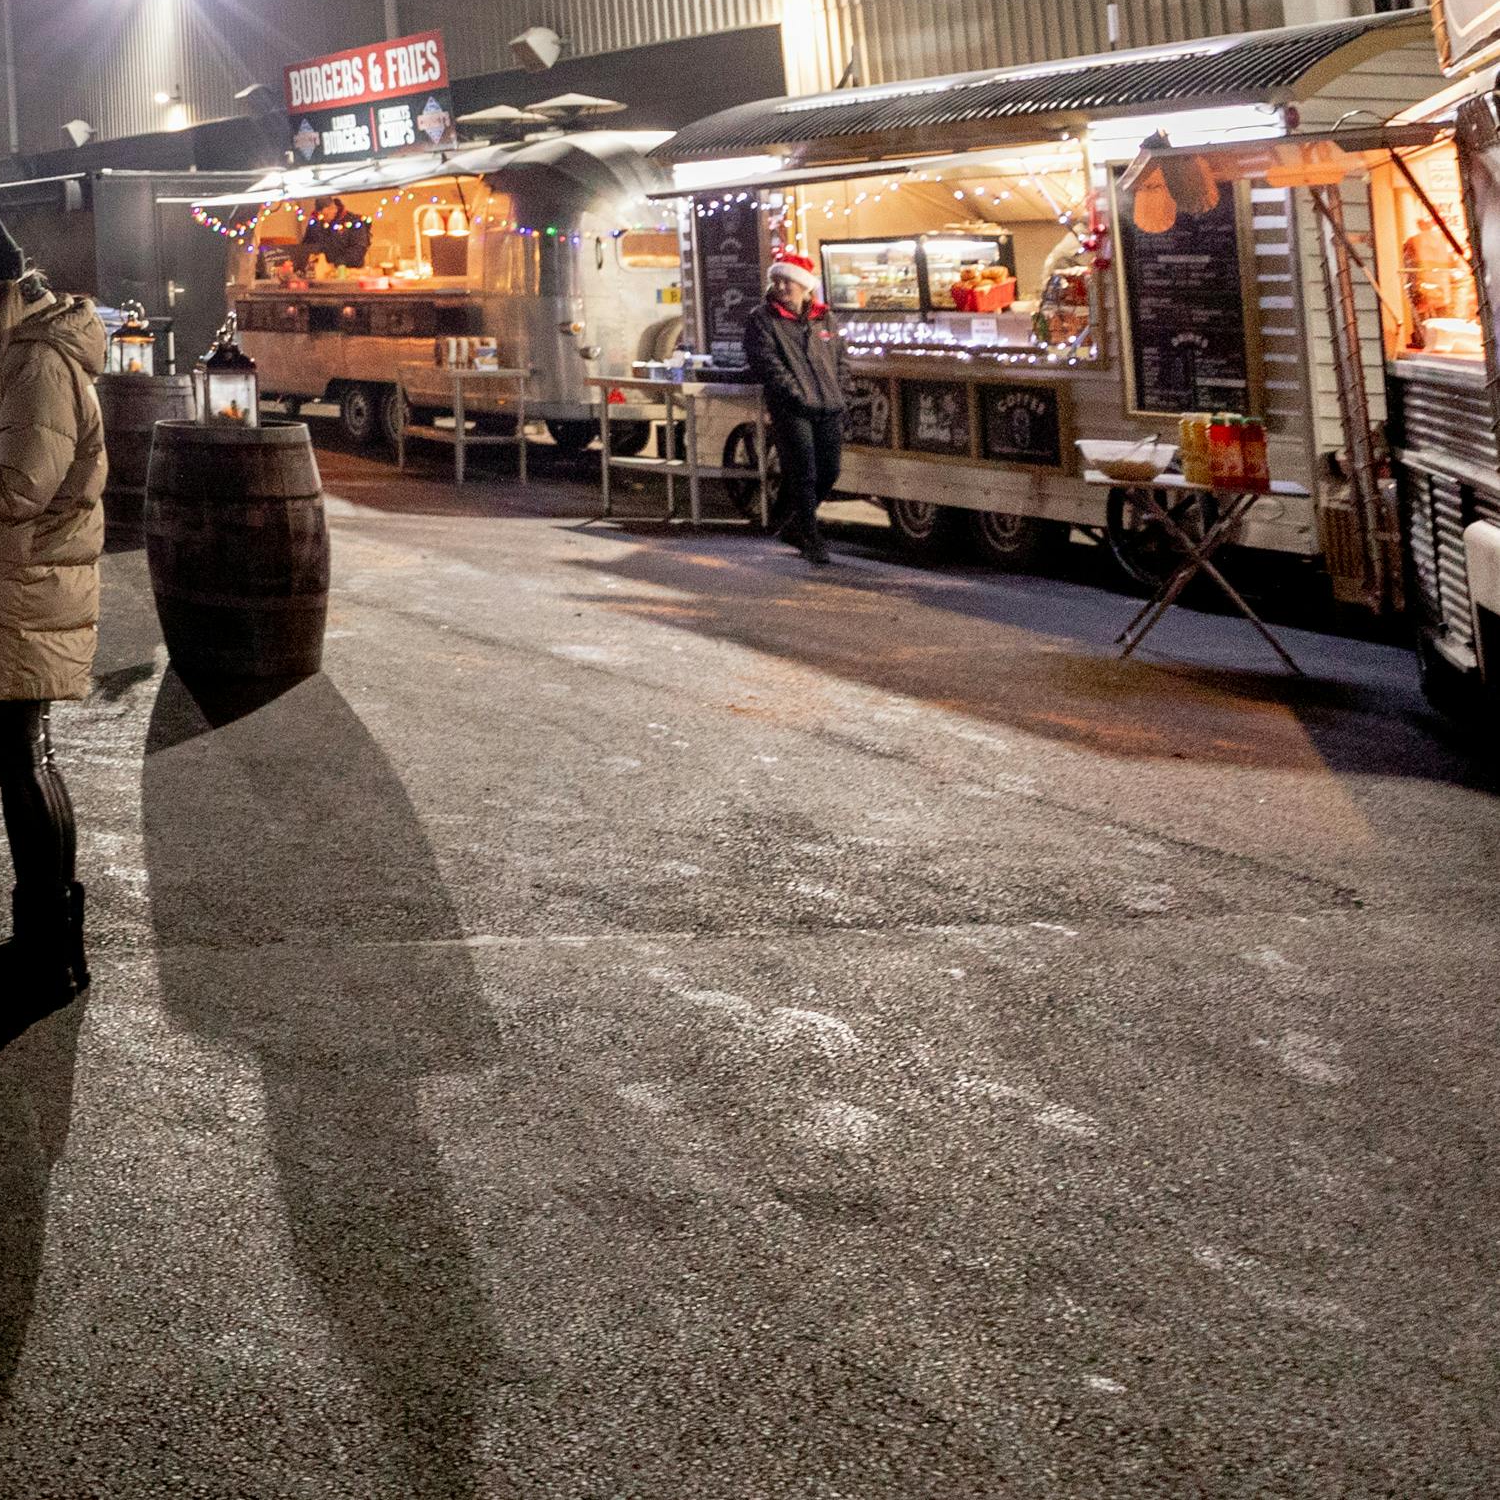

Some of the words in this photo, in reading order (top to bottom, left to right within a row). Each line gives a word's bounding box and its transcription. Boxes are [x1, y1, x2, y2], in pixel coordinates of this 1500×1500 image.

[289, 56, 365, 107] BURGERS
[367, 52, 384, 93] &
[385, 39, 441, 90] FRIES
[321, 125, 371, 155] BURGERS
[378, 118, 416, 148] CHIPS
